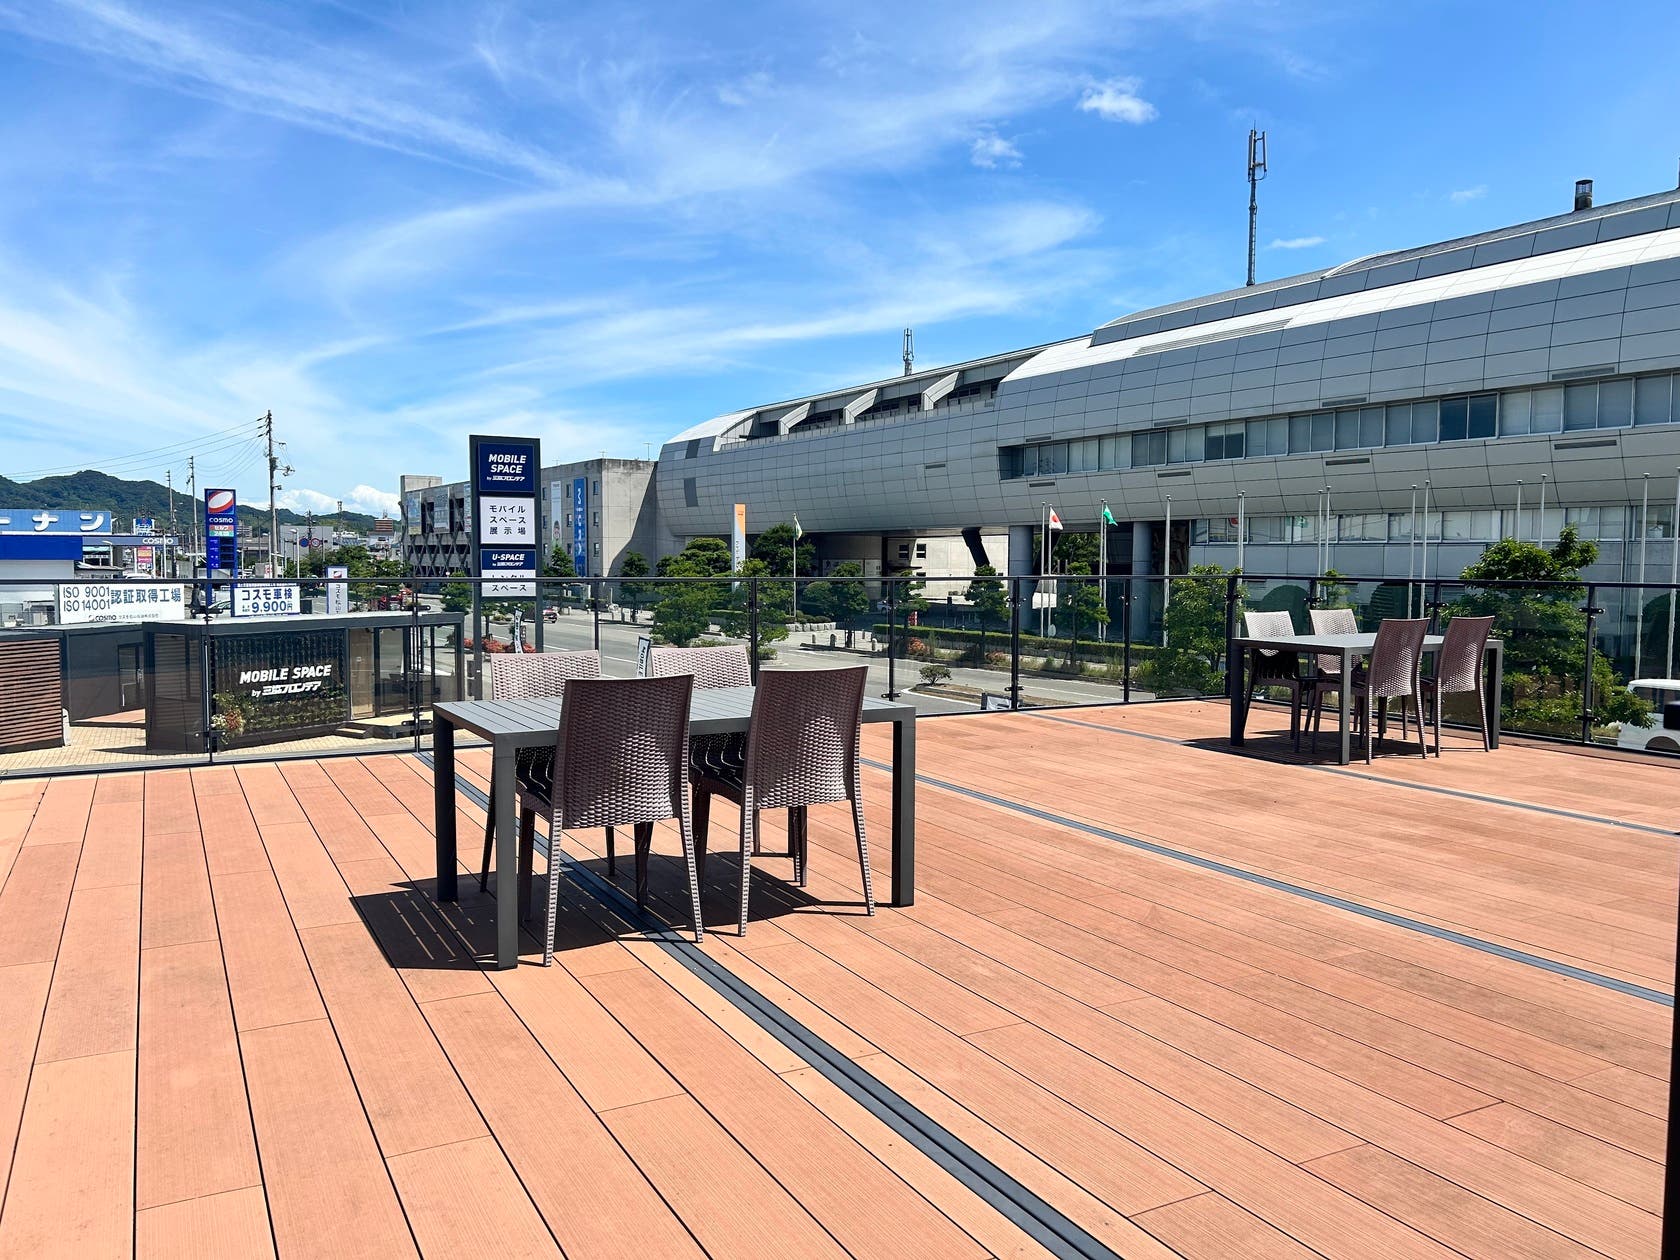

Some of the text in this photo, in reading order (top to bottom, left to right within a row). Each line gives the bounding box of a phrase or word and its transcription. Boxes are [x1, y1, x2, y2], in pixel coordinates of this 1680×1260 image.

[488, 453, 527, 464] MOBILE
[490, 464, 523, 474] SPACE
[489, 504, 526, 514] モバイル
[489, 516, 527, 524] スペース
[489, 526, 526, 536] 展示場
[492, 553, 525, 561] U-SPACE
[63, 585, 110, 599] ISO 9001
[491, 584, 527, 592] スペース
[110, 587, 182, 605] 認証取得工場
[241, 587, 293, 601] コスモ車検
[63, 599, 111, 612] ISO 14001
[239, 664, 332, 685] MOBILE SPACE
[251, 689, 261, 698] by
